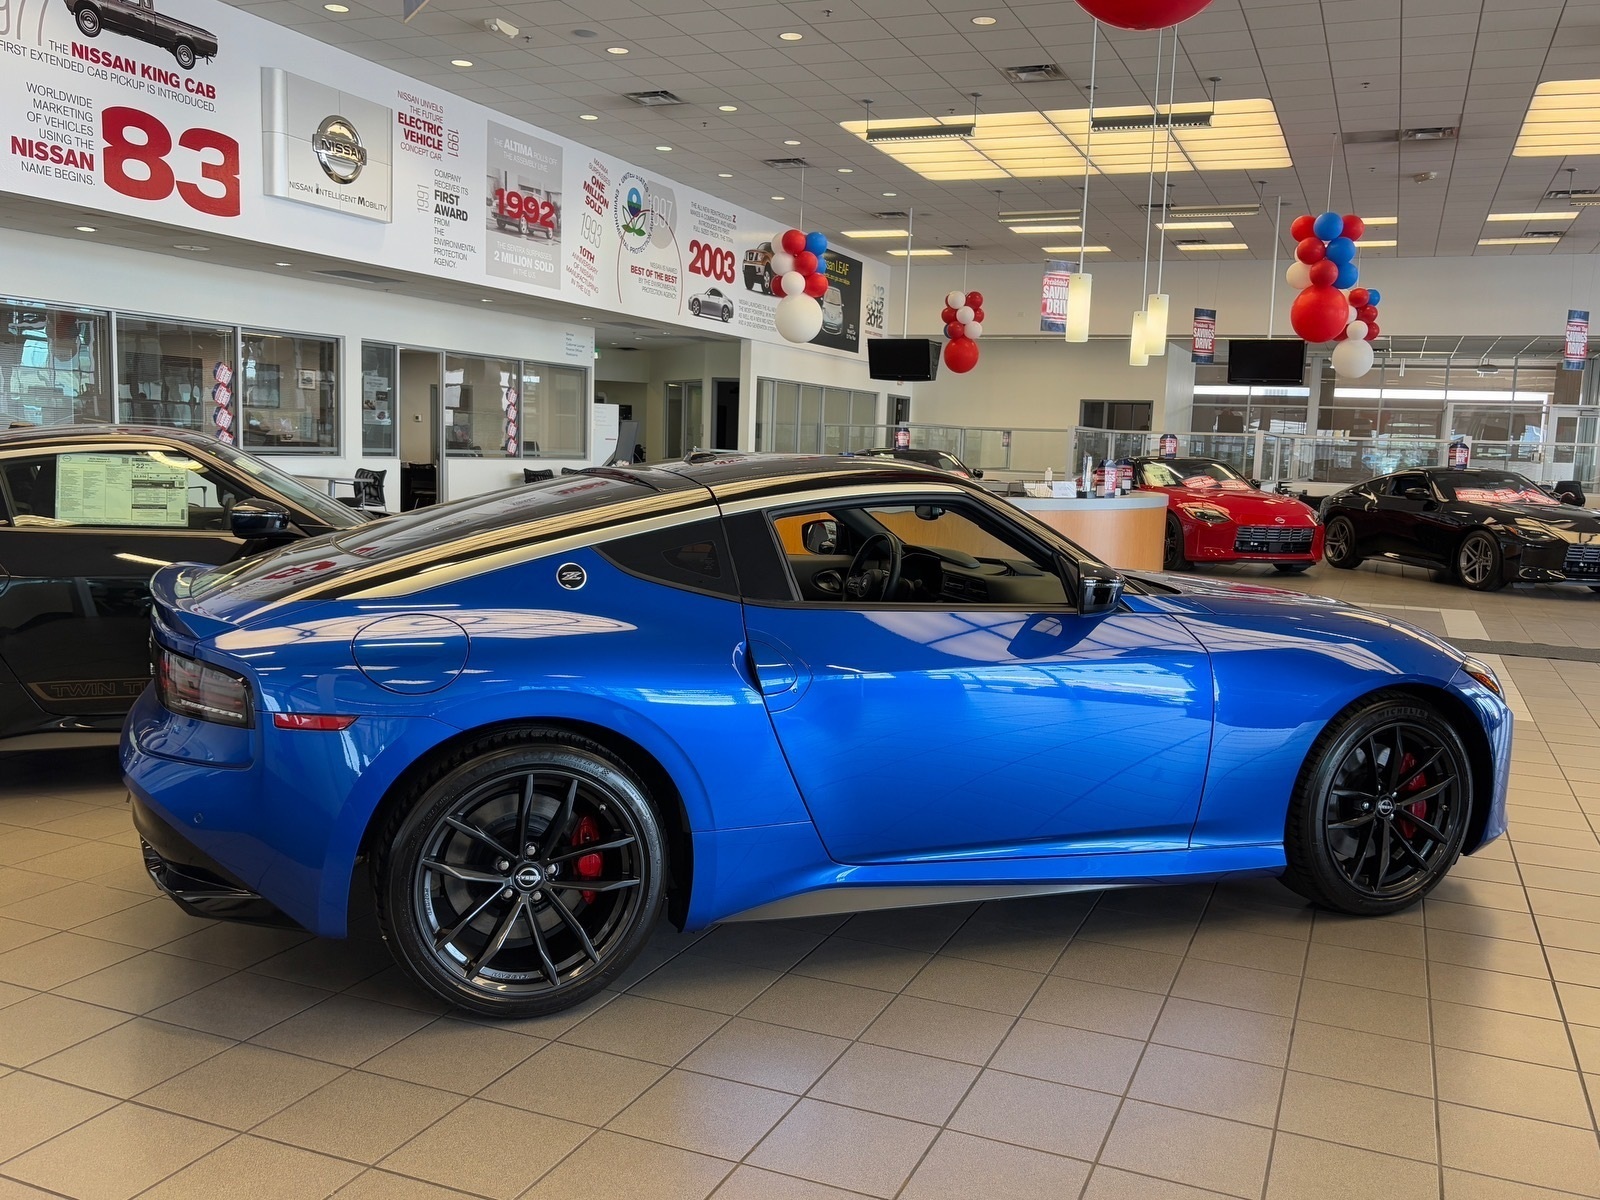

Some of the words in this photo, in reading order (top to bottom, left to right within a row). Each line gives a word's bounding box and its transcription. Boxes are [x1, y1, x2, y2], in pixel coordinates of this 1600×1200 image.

[0, 40, 27, 57] FIRST
[30, 49, 84, 74] EXTENDED
[87, 66, 108, 80] CAB
[110, 73, 145, 91] PICKUP
[147, 84, 155, 95] IS
[157, 88, 217, 113] INTRODUCED.
[49, 40, 69, 55] THE
[72, 42, 136, 75] NISSAN
[141, 63, 180, 89] KING
[184, 78, 216, 100] CAB
[26, 81, 93, 109] WORLDWIDE
[397, 90, 420, 105] NISSAN
[420, 98, 444, 114] UNVEILS
[33, 98, 93, 123] MARKETING
[409, 104, 421, 117] THE
[421, 110, 444, 124] FUTURE
[26, 111, 42, 123] OF
[44, 115, 94, 137] VEHICLES
[398, 111, 443, 137] ELECTRIC
[39, 128, 72, 145] USING
[74, 136, 94, 151] THE
[403, 127, 443, 151] VEHICLE
[447, 129, 460, 157] 1991
[11, 135, 94, 172] NISSAN
[321, 139, 366, 161] NISSAN
[400, 141, 429, 157] CONCEPT
[493, 137, 503, 148] THE
[503, 139, 533, 158] ALTIMA
[533, 151, 549, 164] ROLLS
[549, 157, 558, 166] OFF
[503, 150, 513, 161] THE
[101, 105, 241, 218] 83
[21, 161, 52, 177] NAME
[54, 167, 96, 186] BEGINS.
[434, 168, 461, 183] COMPANY
[434, 180, 460, 194] RECEIVES
[460, 186, 469, 196] ITS
[591, 175, 606, 194] ONE
[289, 181, 313, 193] NISSAN
[357, 196, 387, 212] MOBILITY
[417, 183, 430, 213] 1991
[434, 189, 460, 206] FIRST
[583, 180, 610, 209] MILLION
[434, 203, 468, 222] AWARD
[495, 187, 555, 229] 1992
[585, 195, 603, 217] SOLD.
[434, 216, 450, 227] FROM
[732, 214, 736, 223] Z
[434, 227, 445, 237] THE
[581, 212, 602, 249] 1993
[433, 237, 477, 254] ENVIRONMENTAL
[433, 247, 468, 261] PROTECTION
[580, 245, 595, 264] 10TH
[433, 258, 457, 269] AGENCY.
[494, 250, 500, 261] 2
[501, 251, 533, 269] MILLION
[534, 260, 554, 273] SOLD
[689, 239, 736, 284] 2003
[835, 260, 850, 276] LEAF
[631, 265, 645, 276] BEST
[645, 269, 653, 278] OF
[654, 271, 664, 281] THE
[665, 274, 677, 284] BEST
[1043, 285, 1068, 300] SAVIN
[865, 311, 884, 329] 2012
[1193, 327, 1215, 339] SAVINGS
[1566, 330, 1588, 343] SAVINGS
[1195, 337, 1212, 349] DRIVE
[1567, 342, 1585, 355] DRIVE
[561, 571, 582, 580] Z
[50, 682, 116, 697] TWIN
[1377, 706, 1429, 719] MICHELIN
